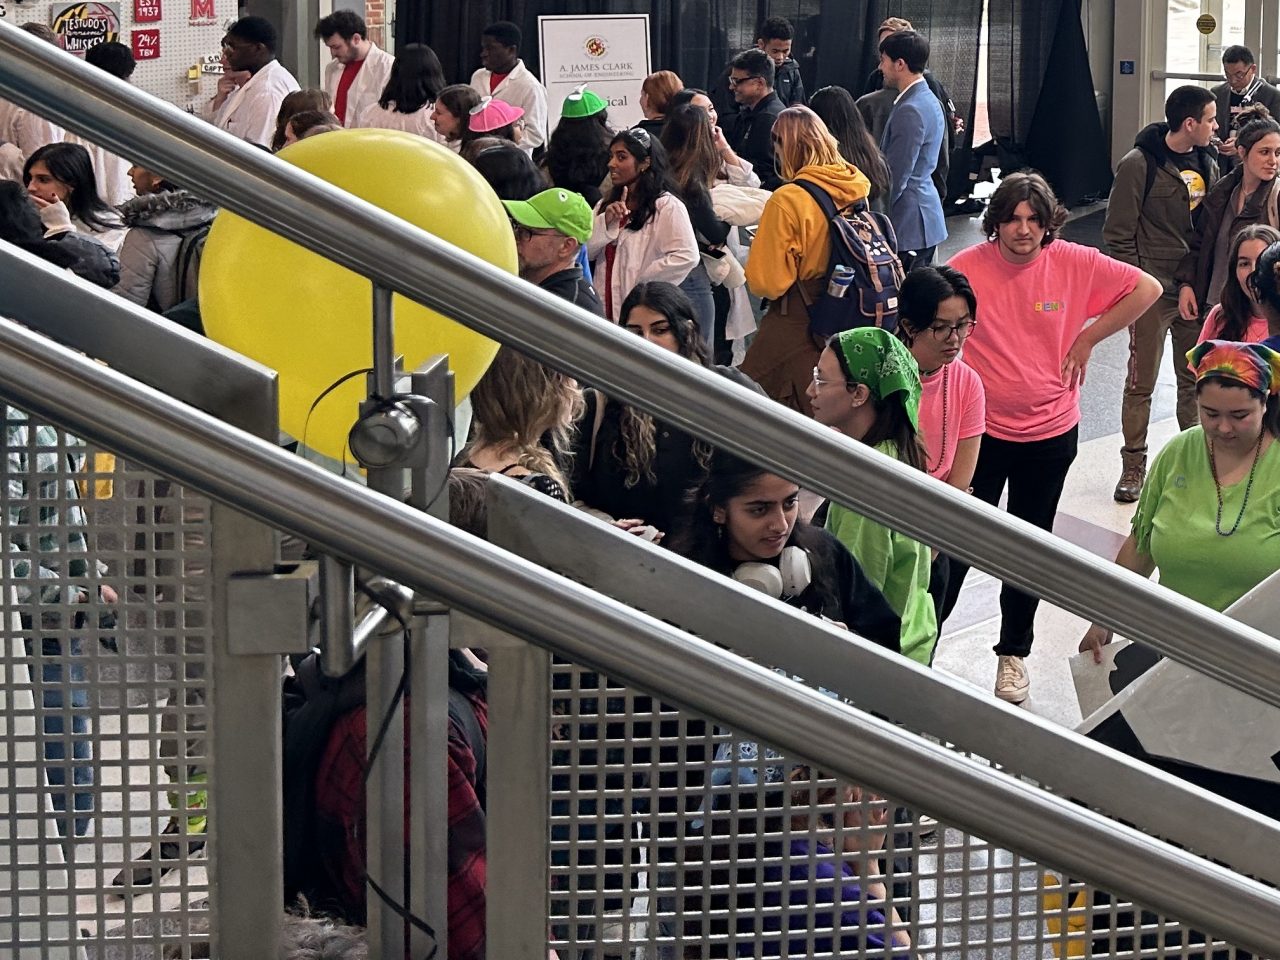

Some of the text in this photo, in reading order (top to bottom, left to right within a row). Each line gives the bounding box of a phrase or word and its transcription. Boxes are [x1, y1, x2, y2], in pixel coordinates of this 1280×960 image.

[138, 7, 159, 17] 1937
[64, 18, 107, 35] TESTUDO'S
[571, 64, 600, 73] JAMES
[602, 62, 633, 70] CLARK
